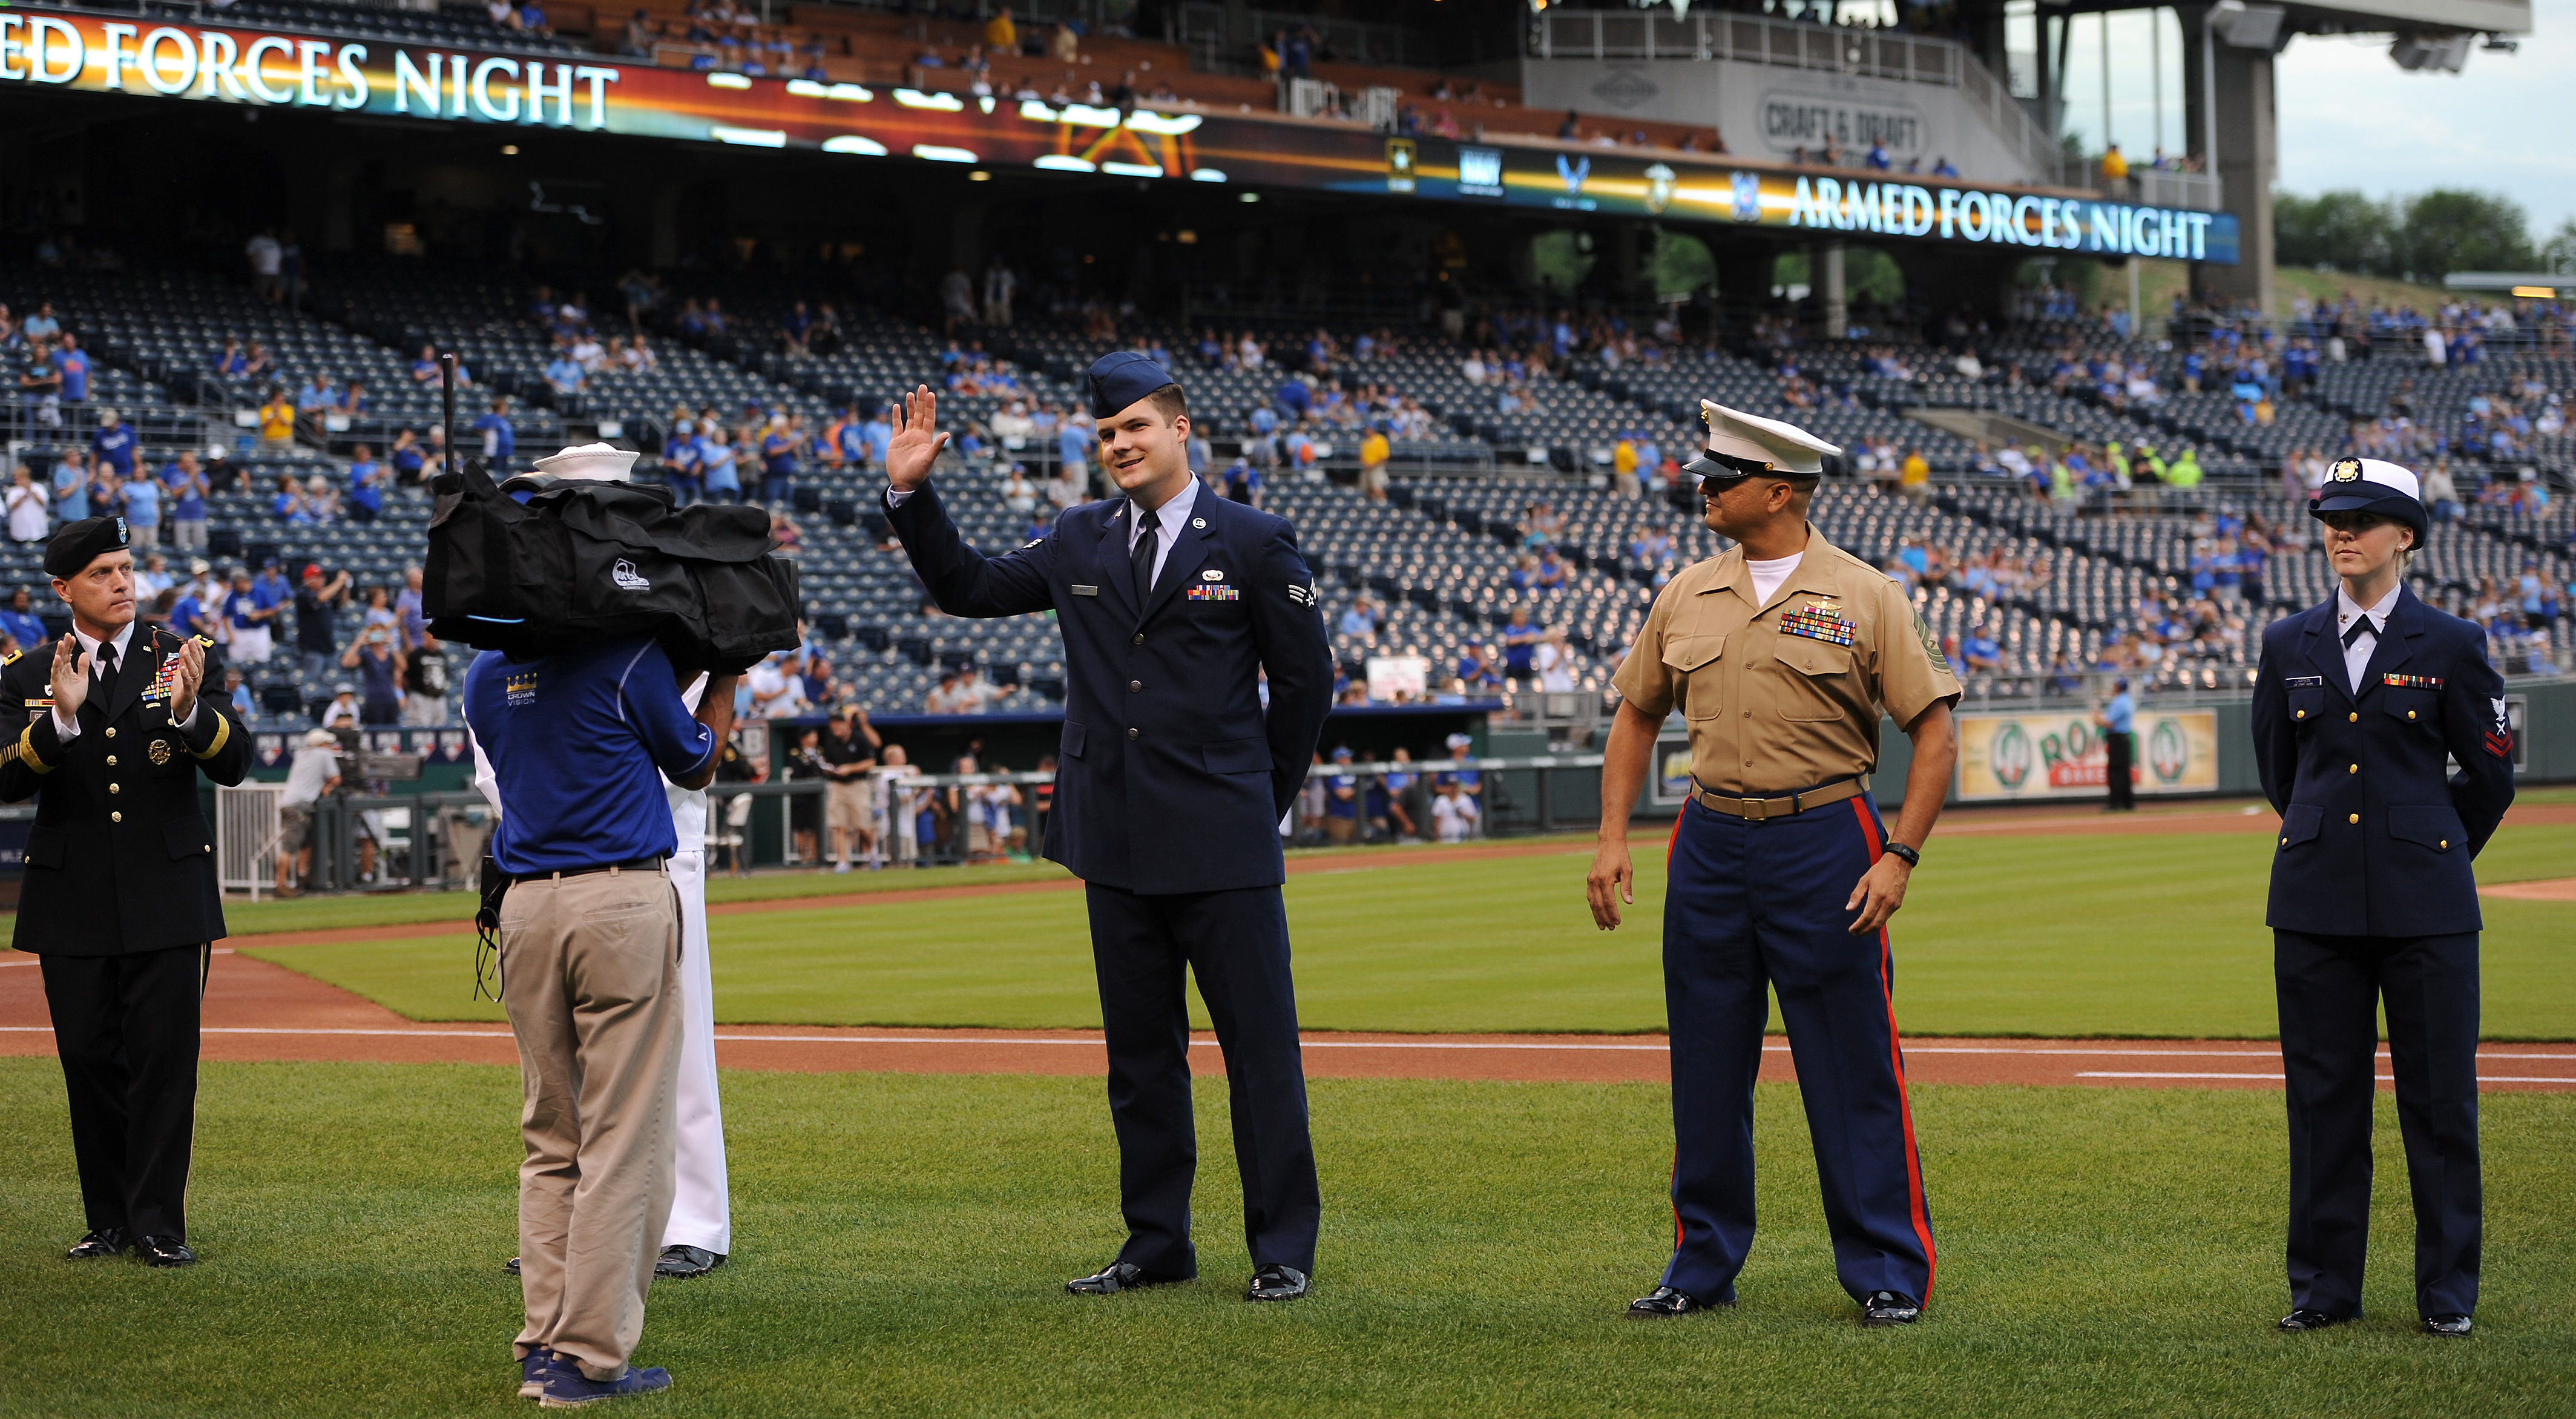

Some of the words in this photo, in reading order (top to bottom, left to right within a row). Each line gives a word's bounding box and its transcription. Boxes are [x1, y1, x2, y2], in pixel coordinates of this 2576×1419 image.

[102, 22, 369, 110] FORCES
[395, 49, 619, 128] NIGHT
[1766, 102, 1828, 140] CRAFT
[1856, 111, 1919, 150] DRAFT
[1789, 176, 1934, 237] ARMED
[1939, 188, 2081, 251] FORCES
[2089, 204, 2212, 260] NIGHT
[508, 691, 535, 700] CROWN
[508, 698, 535, 706] VISION
